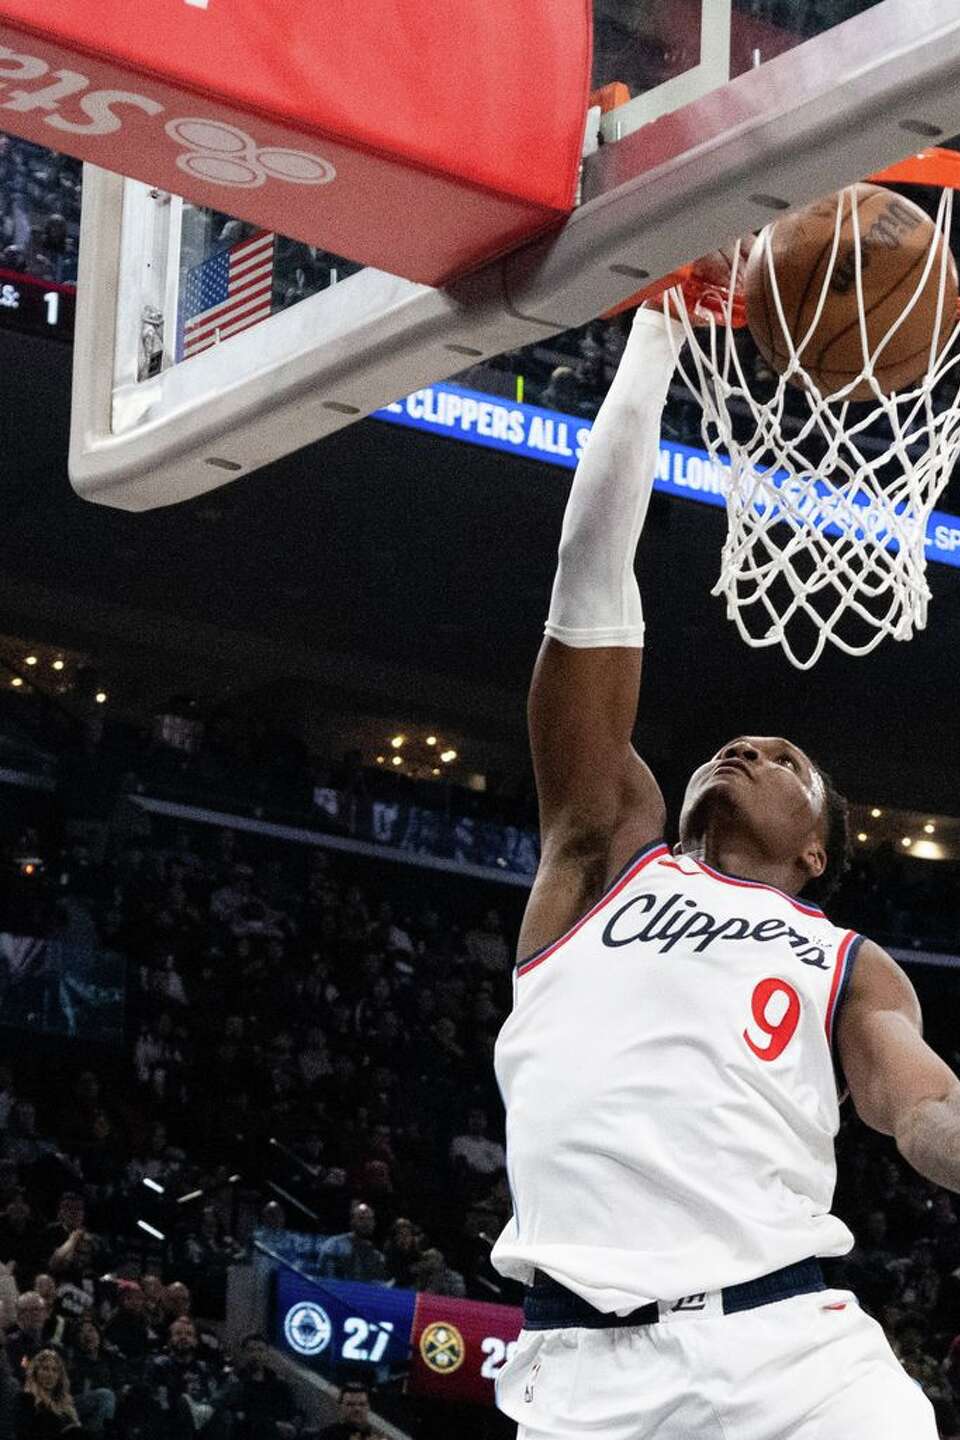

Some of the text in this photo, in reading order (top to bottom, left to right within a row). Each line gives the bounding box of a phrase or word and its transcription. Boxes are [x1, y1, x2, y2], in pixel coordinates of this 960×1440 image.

[43, 291, 59, 325] 1
[406, 388, 526, 446] CLIPPERS
[527, 416, 573, 456] ALL
[602, 893, 831, 970] Clippers
[743, 977, 801, 1062] 9
[341, 1316, 394, 1362] 27
